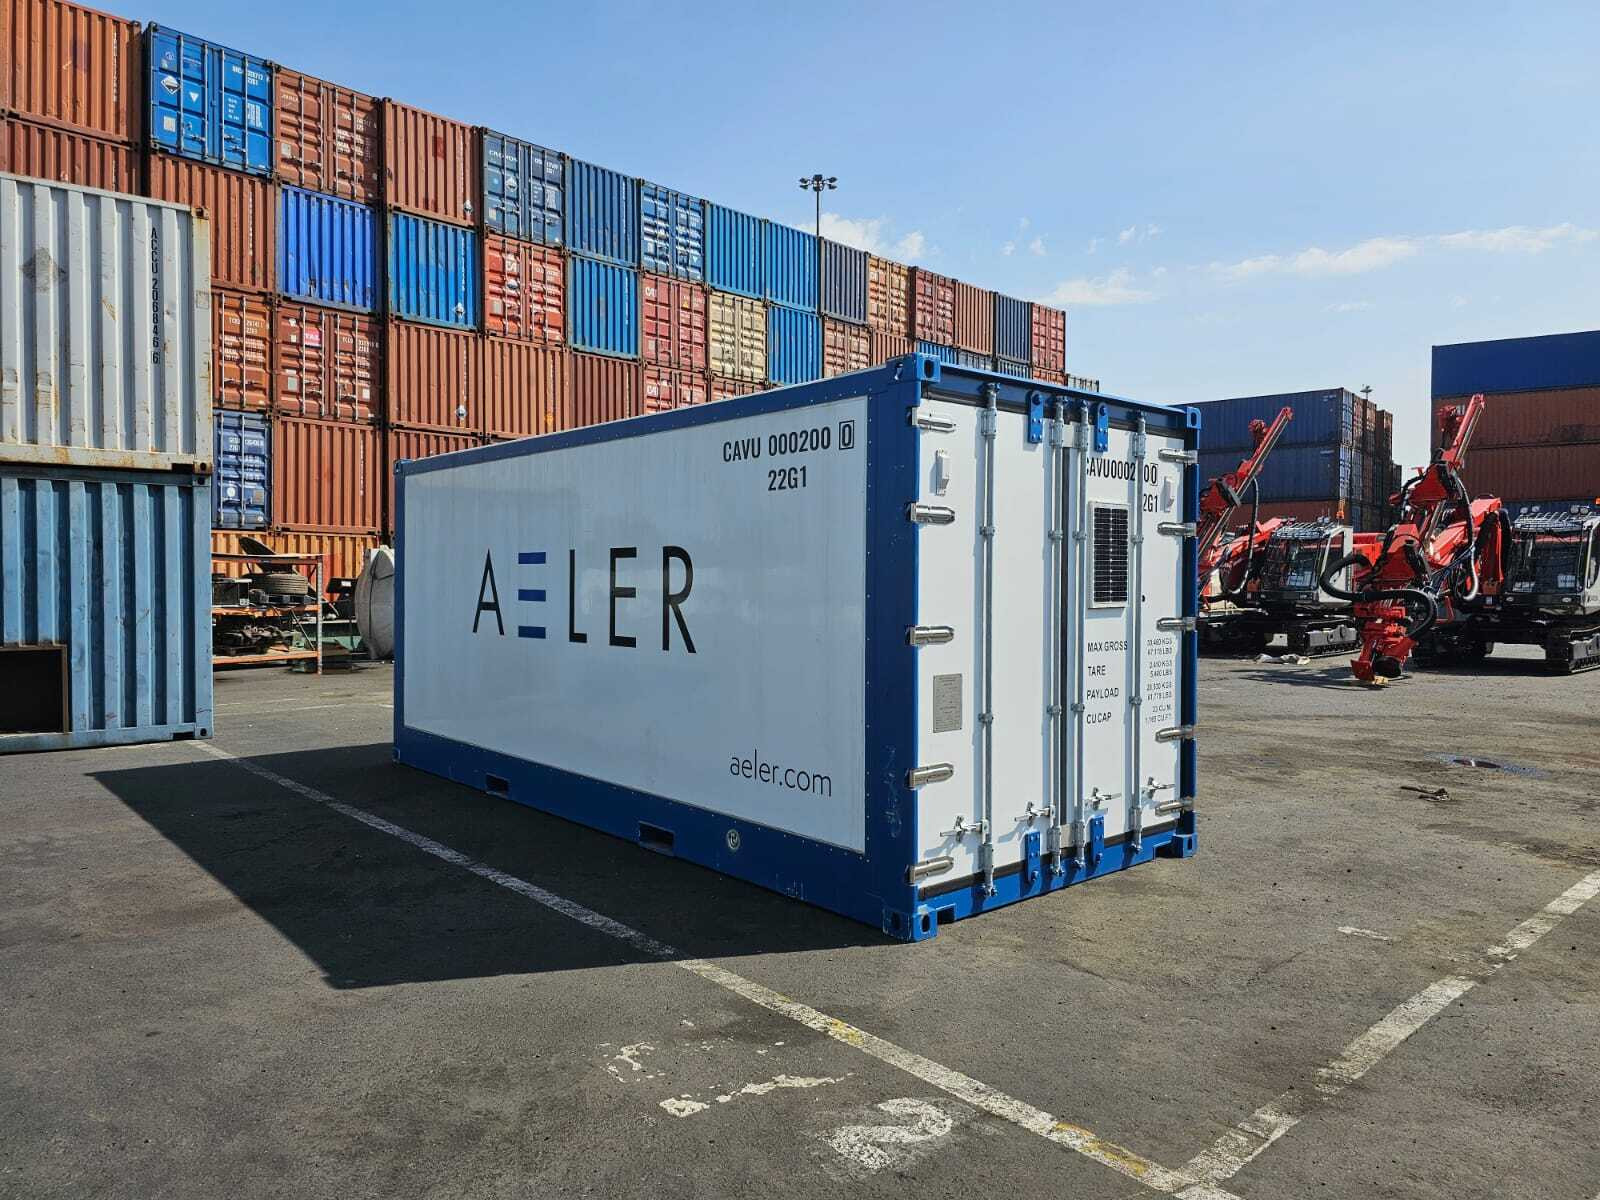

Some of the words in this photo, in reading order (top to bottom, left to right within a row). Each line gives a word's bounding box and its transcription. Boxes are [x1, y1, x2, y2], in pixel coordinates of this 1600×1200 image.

[151, 227, 159, 274] ACCU
[152, 278, 160, 348] 206846
[152, 352, 159, 364] 6
[723, 437, 761, 462] CAVU
[768, 427, 831, 456] 000200
[840, 422, 853, 448] 0
[768, 466, 808, 491] 22G1
[1143, 494, 1158, 513] 2G1
[472, 546, 697, 653] AELER
[1087, 642, 1103, 653] MAX
[1104, 640, 1128, 652] GROSS
[1088, 665, 1106, 677] TARE
[1087, 687, 1119, 701] PAYLOAD
[730, 749, 832, 797] aeler.com
